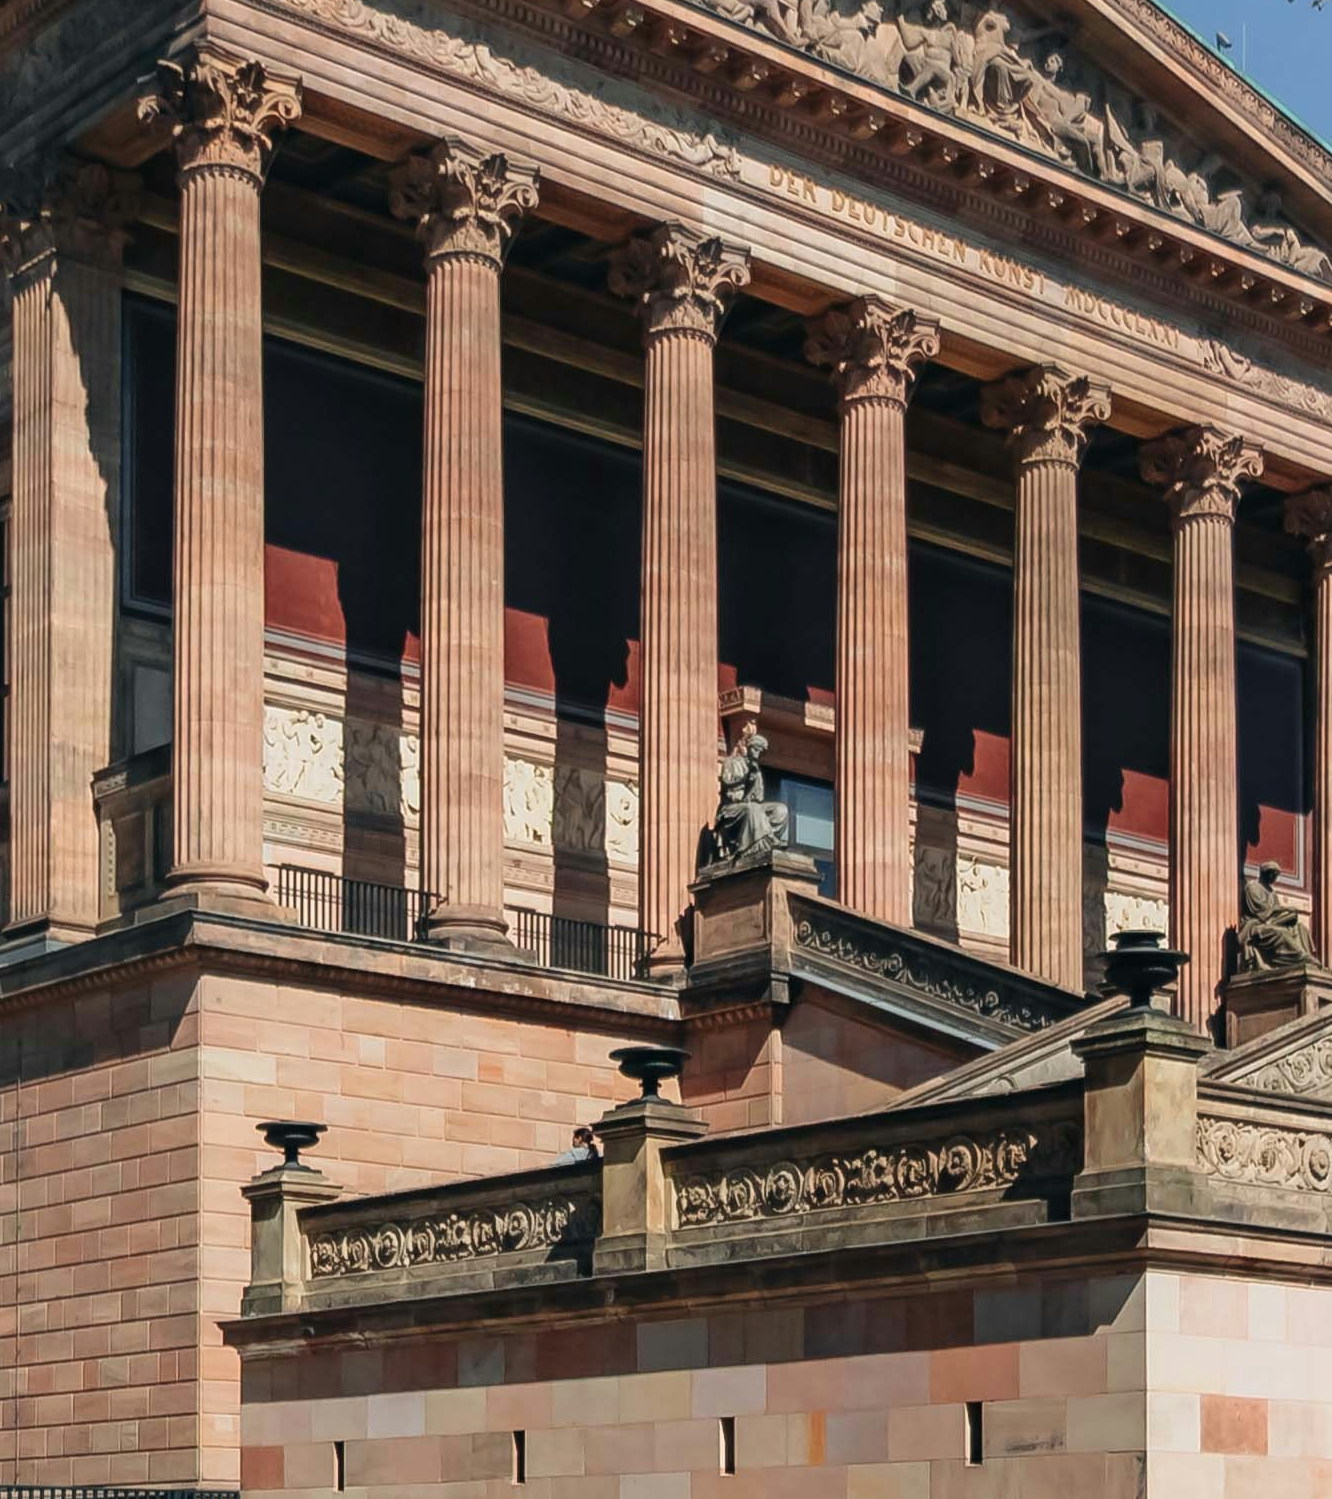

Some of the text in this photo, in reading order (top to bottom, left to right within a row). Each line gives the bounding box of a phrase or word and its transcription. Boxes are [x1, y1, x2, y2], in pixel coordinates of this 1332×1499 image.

[830, 189, 967, 263] DEUTSCHEN
[979, 249, 1045, 294] KUNST
[1064, 285, 1180, 349] MDCCCLXXI
